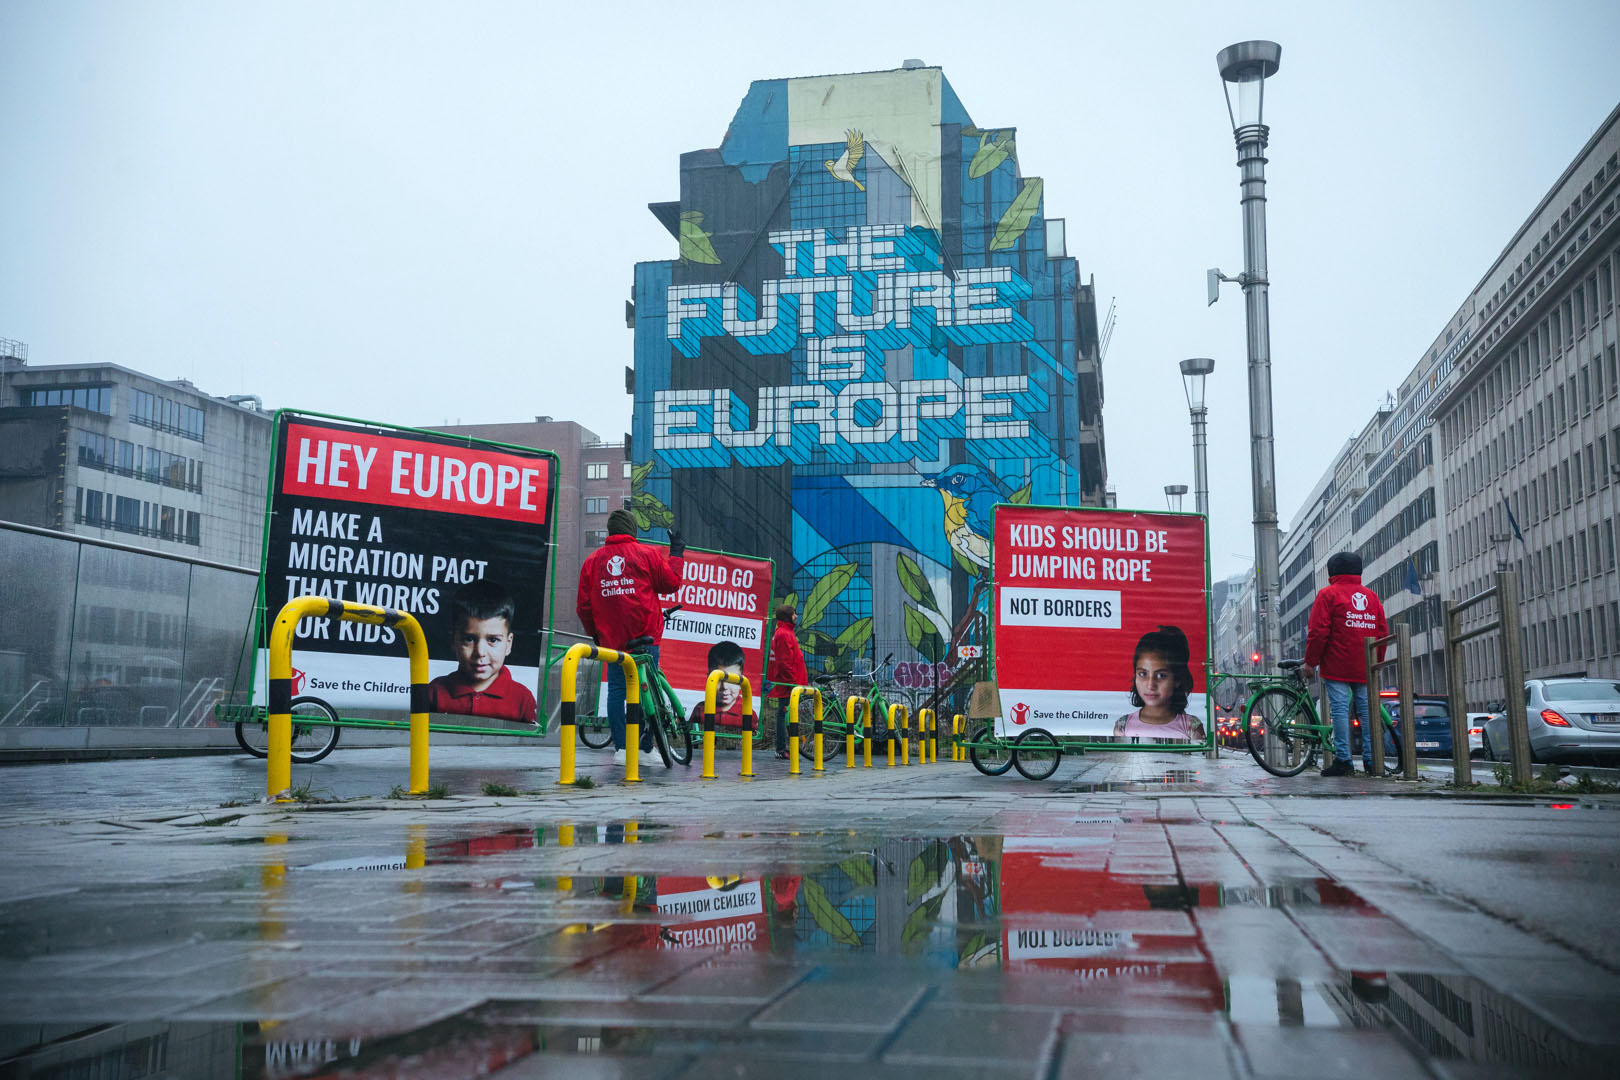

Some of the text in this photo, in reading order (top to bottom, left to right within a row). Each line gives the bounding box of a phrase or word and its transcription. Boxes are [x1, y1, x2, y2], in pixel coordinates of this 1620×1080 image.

[769, 224, 906, 276] THE
[667, 266, 1013, 340] FUTURE
[806, 334, 867, 382] IS
[653, 375, 1031, 450] EUROPE
[297, 437, 541, 512] HEY EUROPE
[291, 508, 383, 544] MAKE A
[1010, 524, 1168, 554] KIDS SHOULD BE
[288, 541, 489, 585] MIGRATION PACT
[683, 561, 754, 589] OULD GO
[1010, 553, 1152, 582] JUMPING ROPE
[286, 576, 441, 615] THAT WORKS
[600, 577, 634, 588] Save the
[601, 587, 636, 597] Children
[1010, 597, 1112, 619] NOT BORDERS
[1346, 611, 1376, 620] Save the
[295, 616, 396, 645] OR KIDS
[665, 618, 757, 640] ETENTION CENTRES
[1345, 619, 1376, 629] Children
[310, 678, 339, 690] Save
[342, 680, 361, 691] the
[1033, 709, 1109, 720] Save the Children
